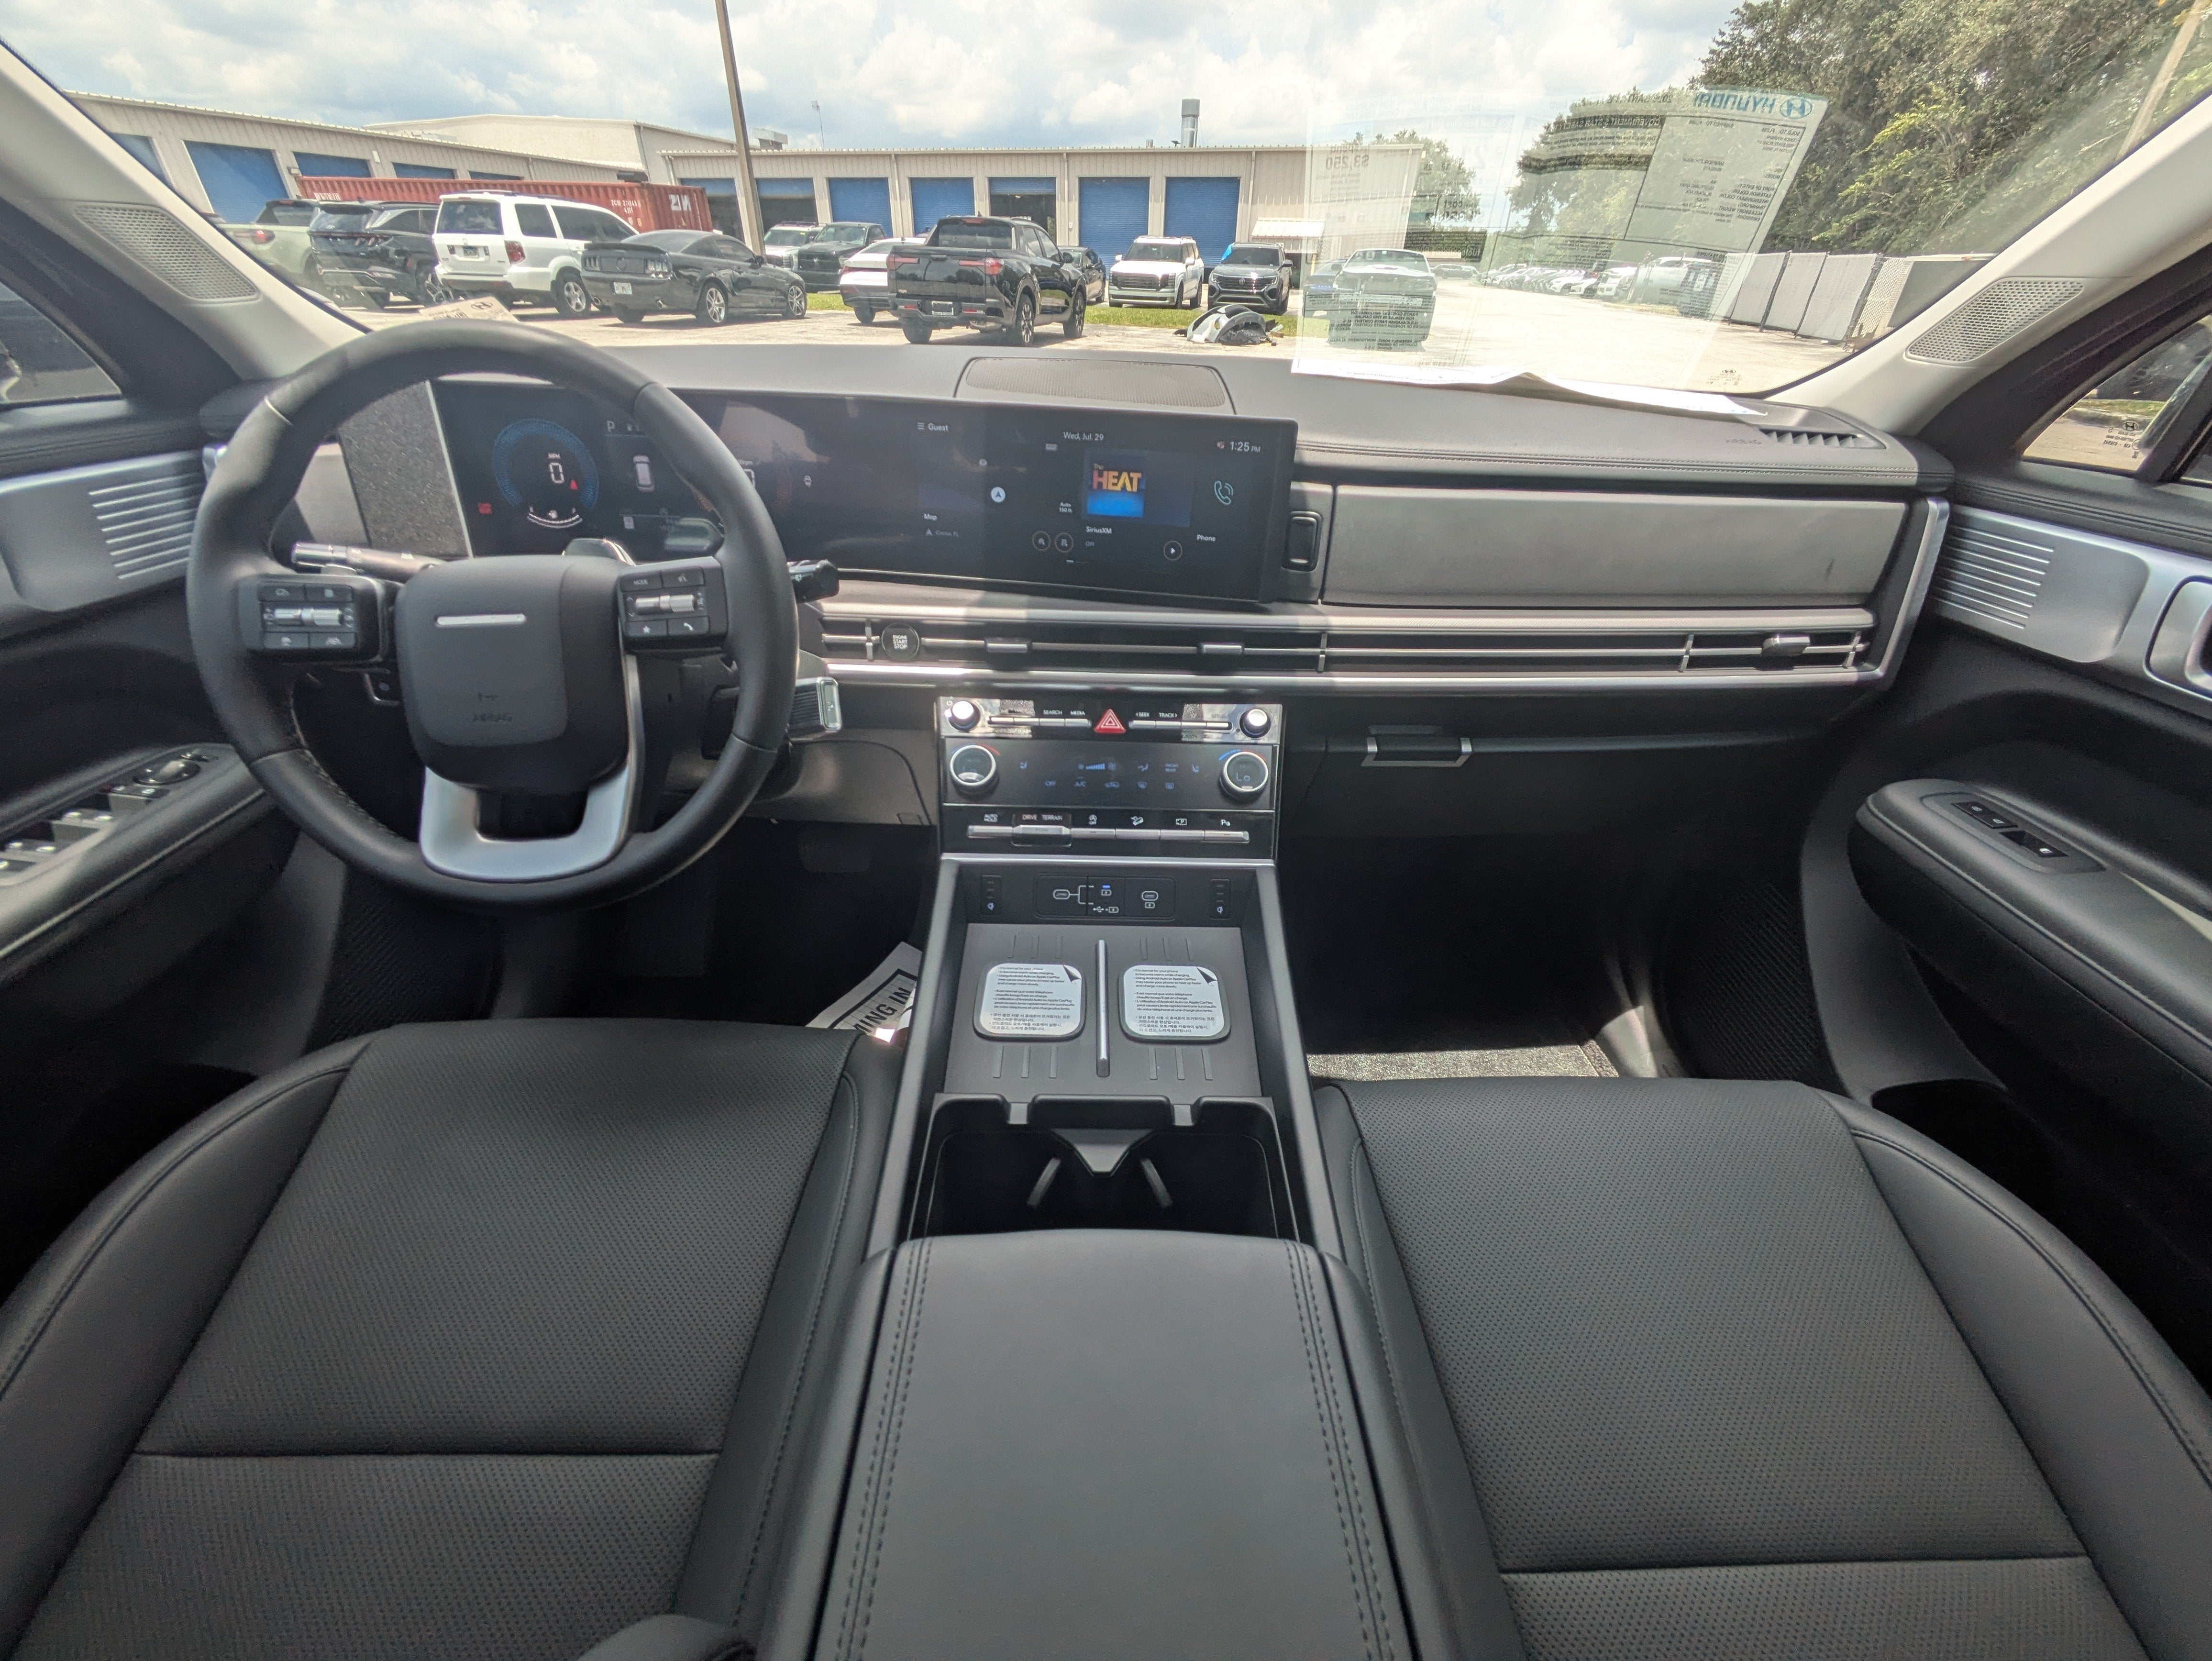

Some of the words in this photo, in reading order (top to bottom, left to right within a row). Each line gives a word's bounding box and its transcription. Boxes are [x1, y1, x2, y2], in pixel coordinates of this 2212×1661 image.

[607, 421, 615, 432] P
[928, 423, 948, 432] Guest
[1063, 432, 1081, 441] Wed,
[1082, 432, 1093, 441] Jul.
[1229, 442, 1250, 452] 1:25
[548, 462, 564, 484] 0
[1093, 470, 1142, 492] HEAT
[923, 513, 937, 521] Map
[1086, 526, 1112, 534] SiriusXM
[1196, 534, 1216, 543] Phone
[888, 987, 911, 1005] IN
